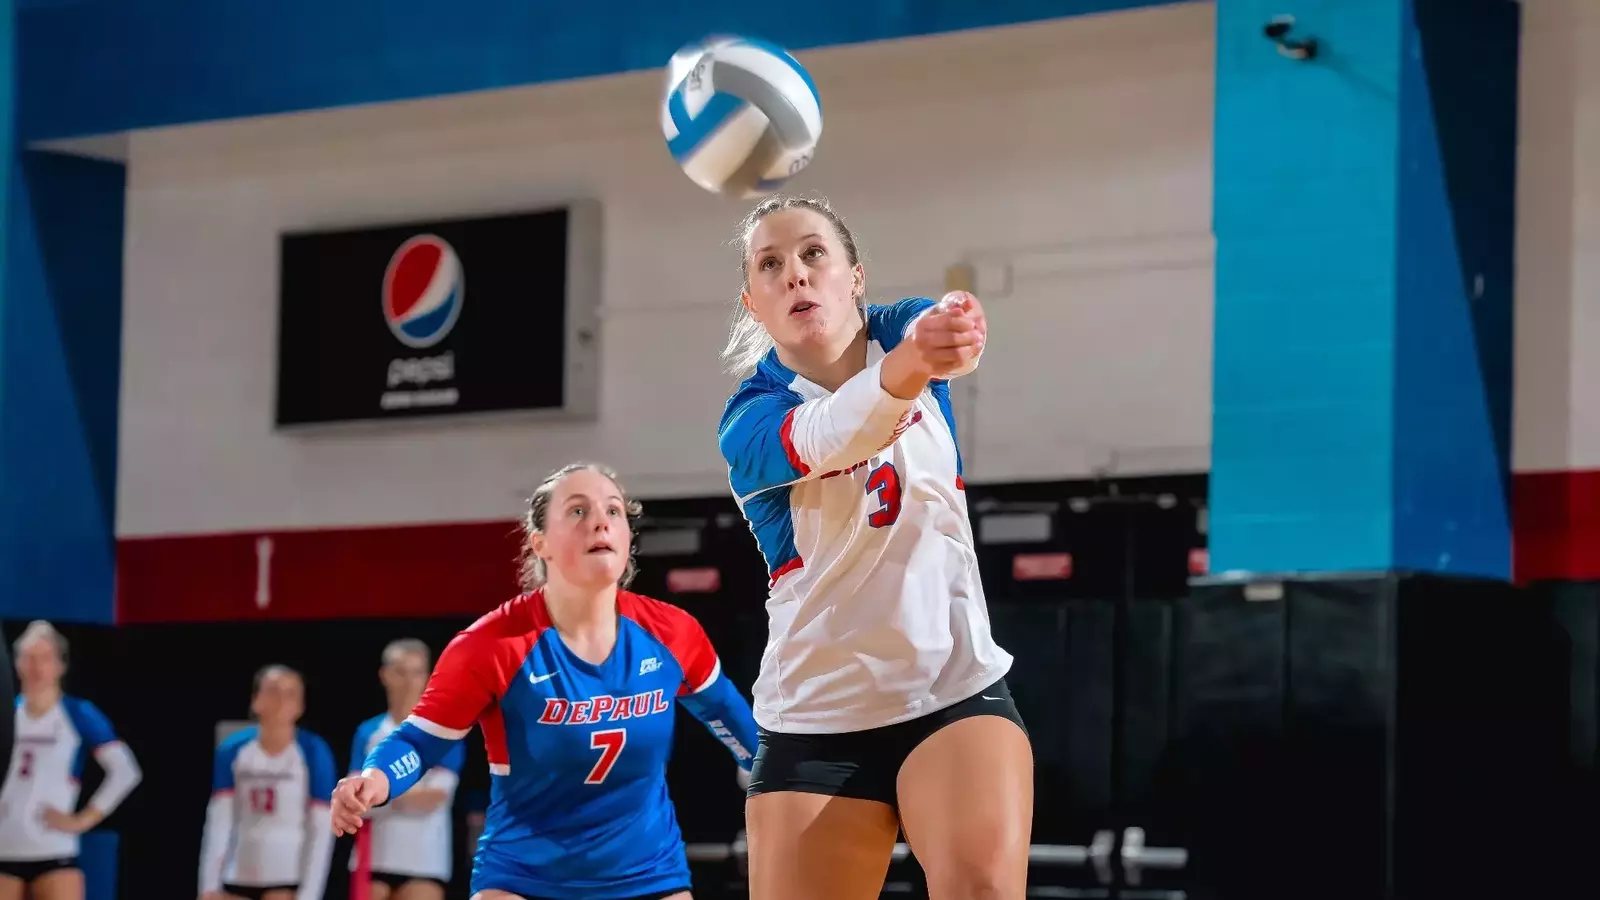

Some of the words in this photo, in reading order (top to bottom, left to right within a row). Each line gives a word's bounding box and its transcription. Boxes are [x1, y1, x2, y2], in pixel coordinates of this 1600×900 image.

[864, 461, 902, 528] 3
[536, 688, 669, 725] DEPAUL
[584, 727, 627, 784] 7
